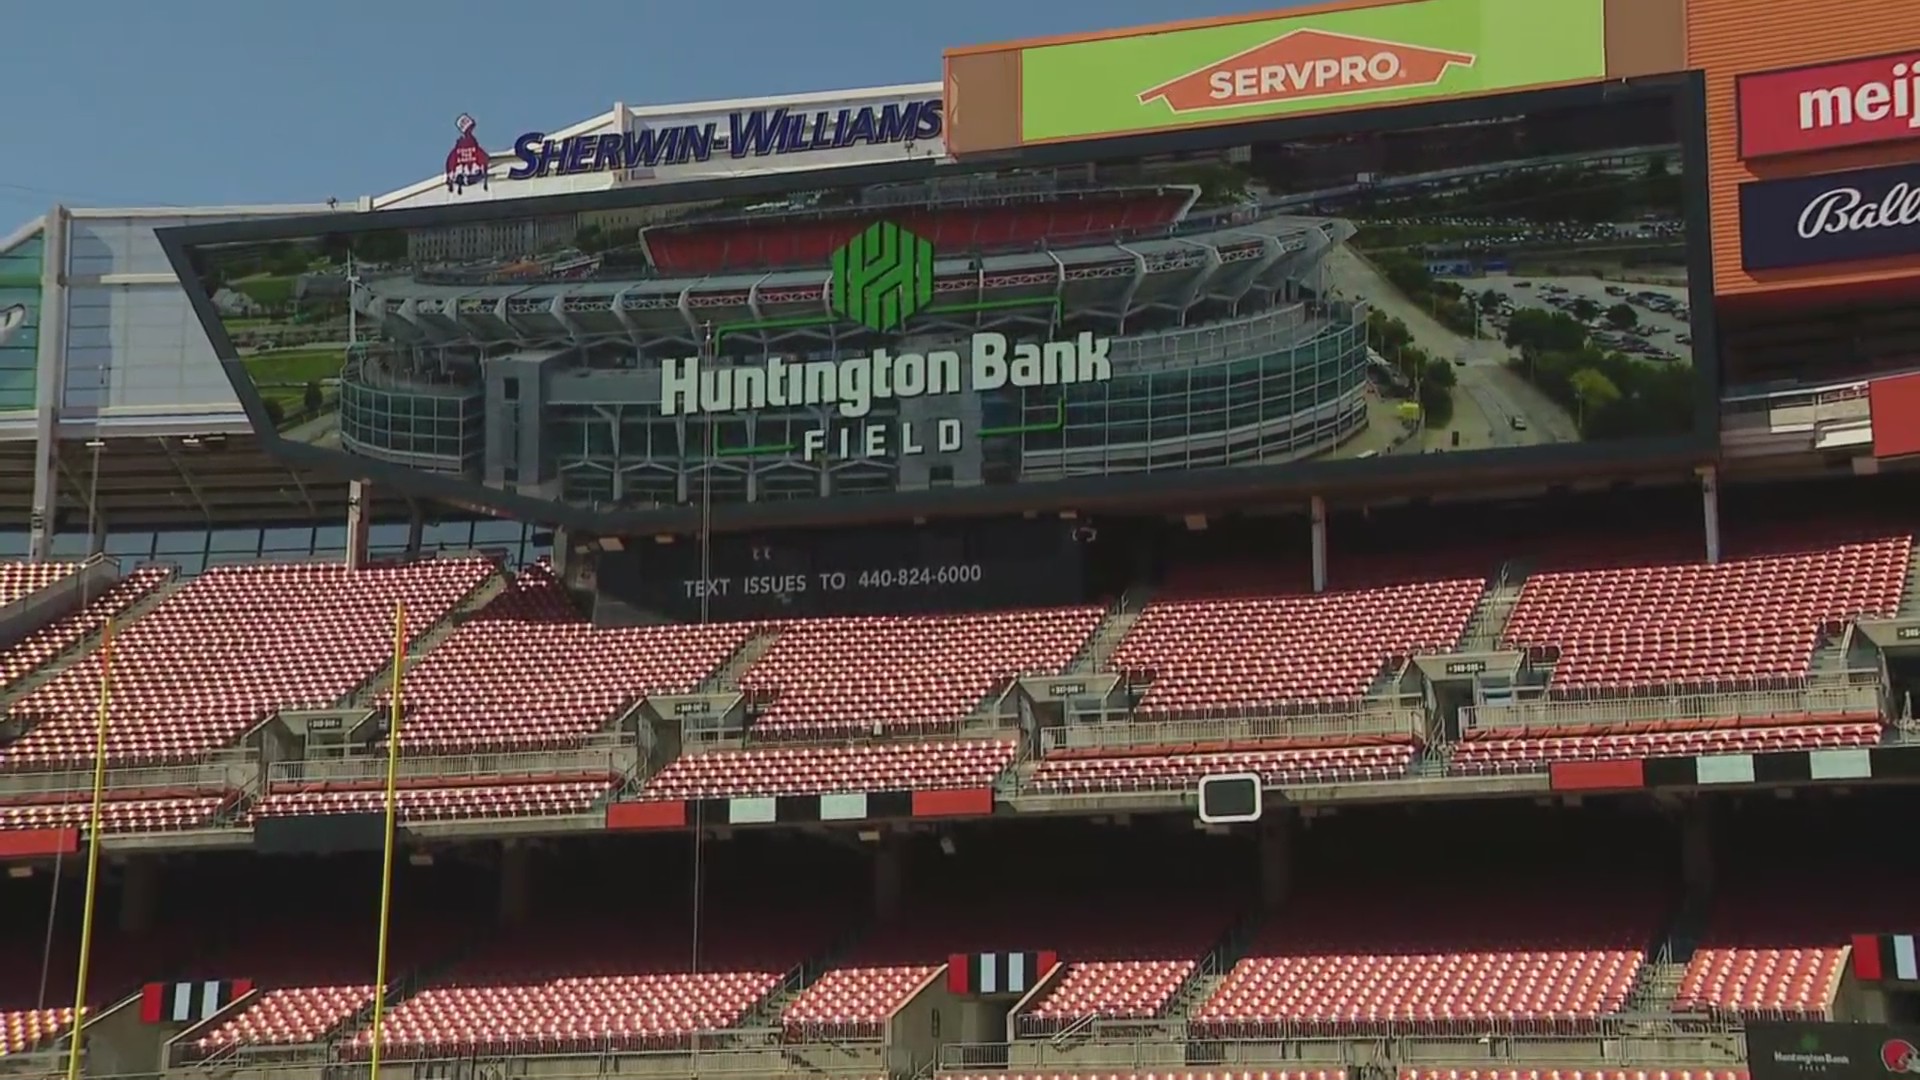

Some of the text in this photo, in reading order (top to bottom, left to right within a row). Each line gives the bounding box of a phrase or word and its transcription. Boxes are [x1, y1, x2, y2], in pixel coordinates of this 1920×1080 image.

[1209, 51, 1400, 99] SERVPRO
[508, 99, 943, 180] SHERWIN-WILLIAMS
[660, 331, 1112, 417] Huntington Bank
[803, 418, 962, 461] FIELD
[684, 564, 982, 598] TEXT ISSUES TO 440-824-6000
[1774, 1051, 1850, 1064] Huntington Bank
